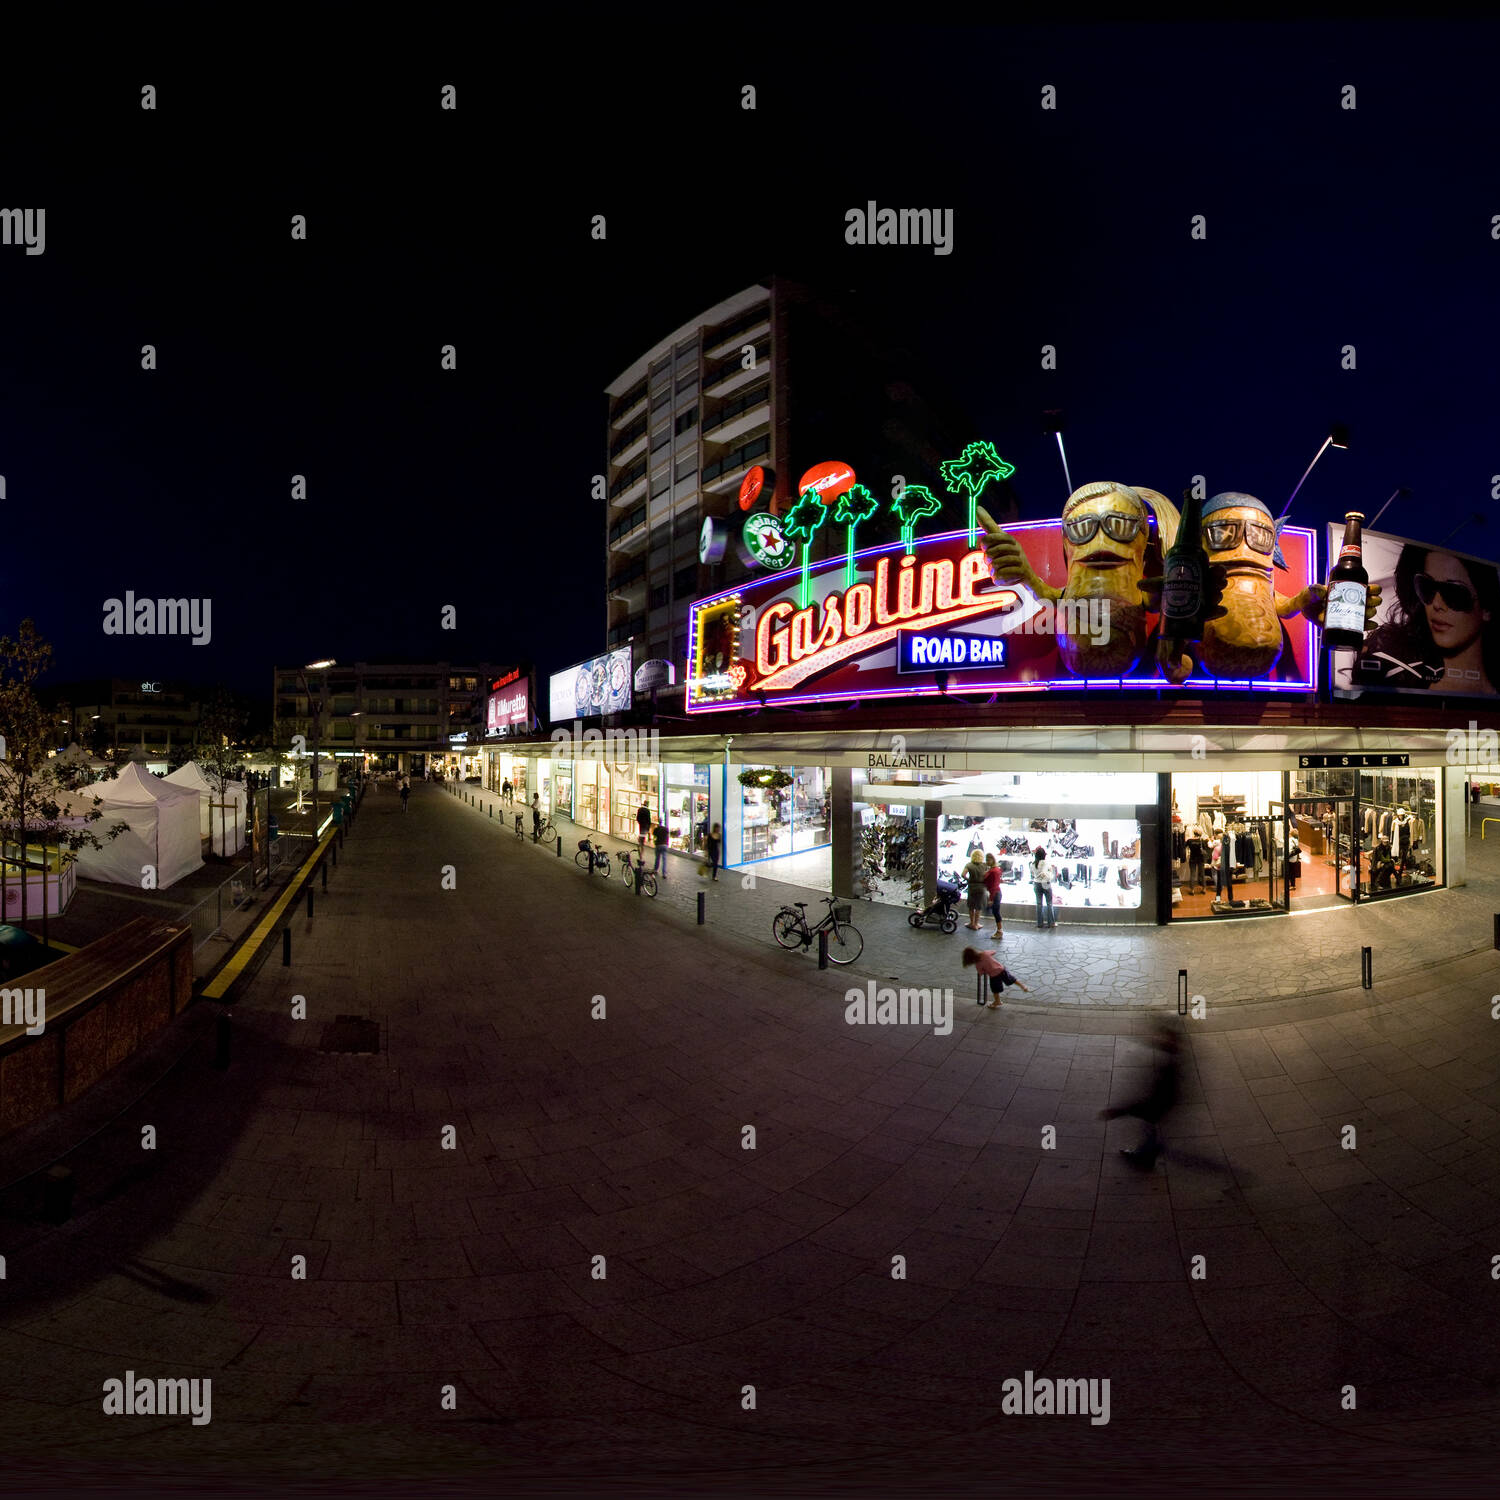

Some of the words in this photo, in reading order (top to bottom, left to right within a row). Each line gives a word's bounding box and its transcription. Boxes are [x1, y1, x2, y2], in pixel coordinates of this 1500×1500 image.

[757, 549, 784, 567] Beer
[756, 550, 991, 676] Gasoline
[912, 636, 966, 664] ROAD
[970, 640, 1004, 662] BAR
[868, 753, 946, 769] BALZANELLI
[1302, 755, 1408, 767] SISLEY
